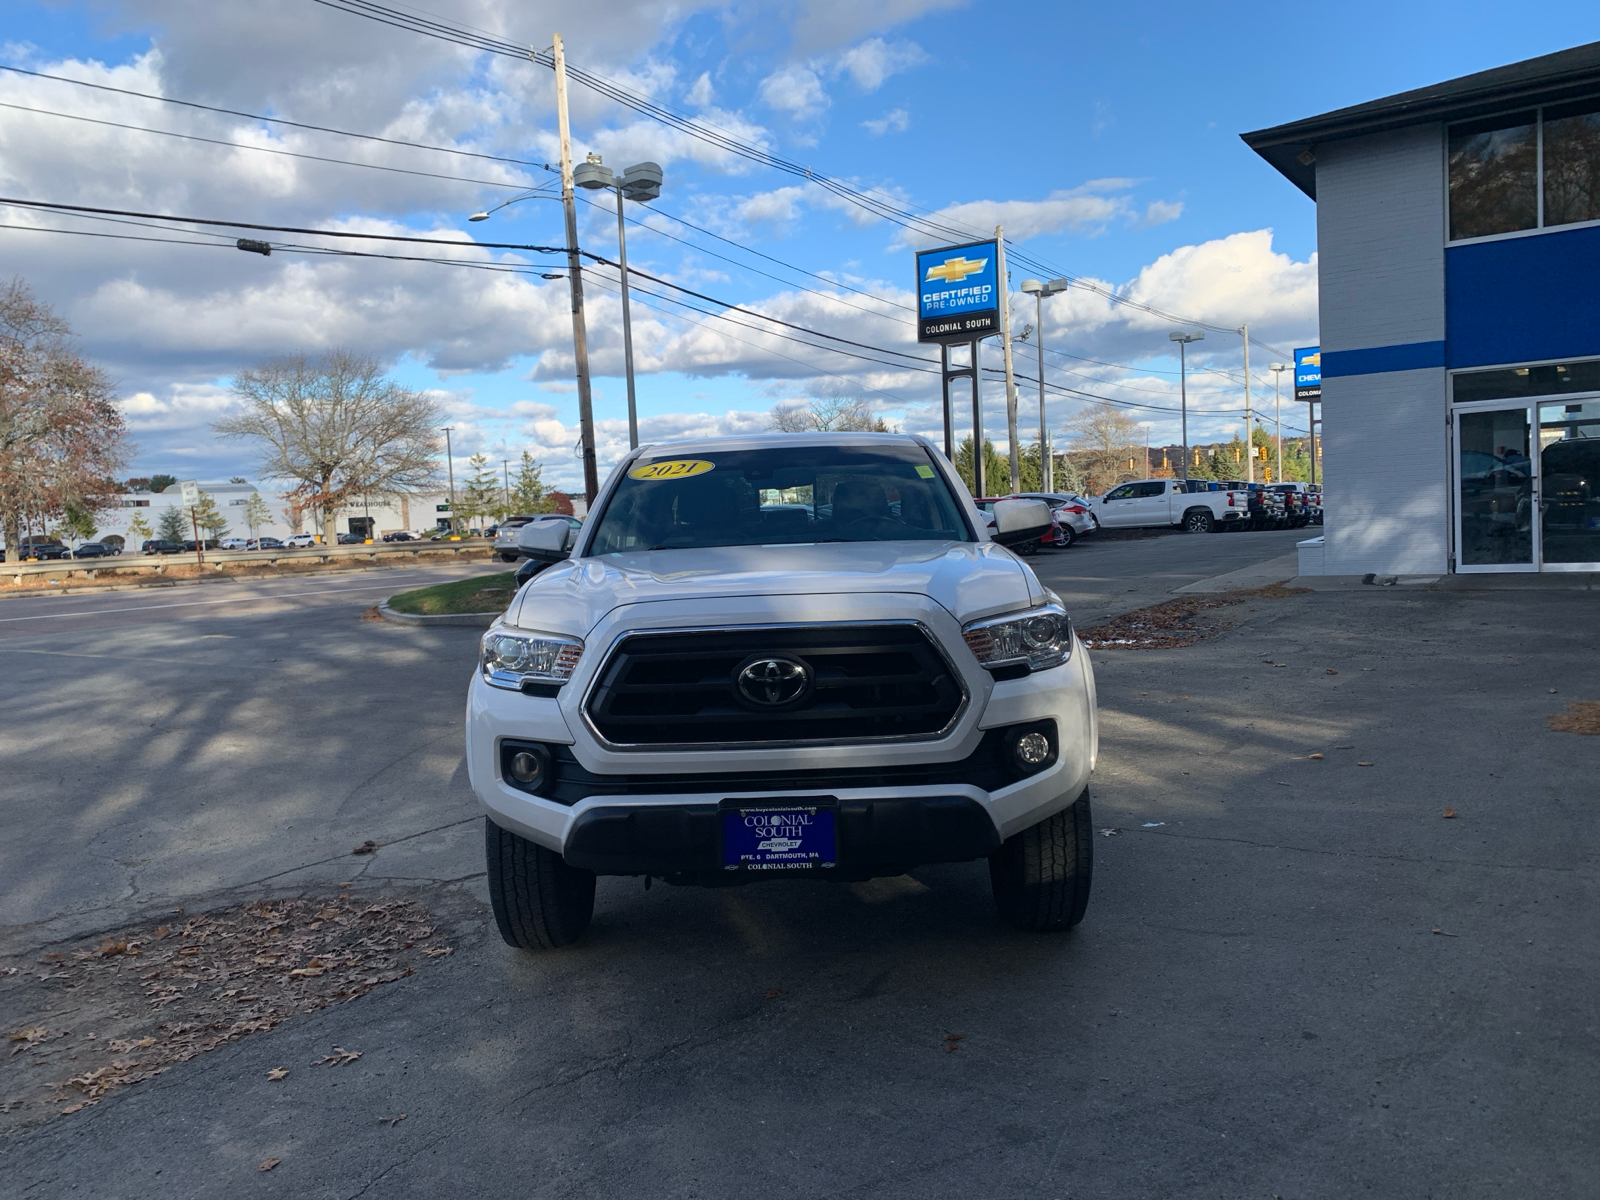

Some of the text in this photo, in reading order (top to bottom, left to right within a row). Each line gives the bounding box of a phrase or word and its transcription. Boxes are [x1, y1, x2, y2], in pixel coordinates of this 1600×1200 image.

[923, 285, 992, 303] CERTIFIED
[926, 294, 989, 310] PRE-OWNED
[925, 317, 991, 334] COLONIAL SOUTH
[1298, 373, 1321, 382] CHEV
[641, 462, 699, 478] 2021
[744, 814, 813, 827] COLONIAL
[755, 825, 803, 838] SOUTH
[765, 852, 808, 860] DARTMOUTH,
